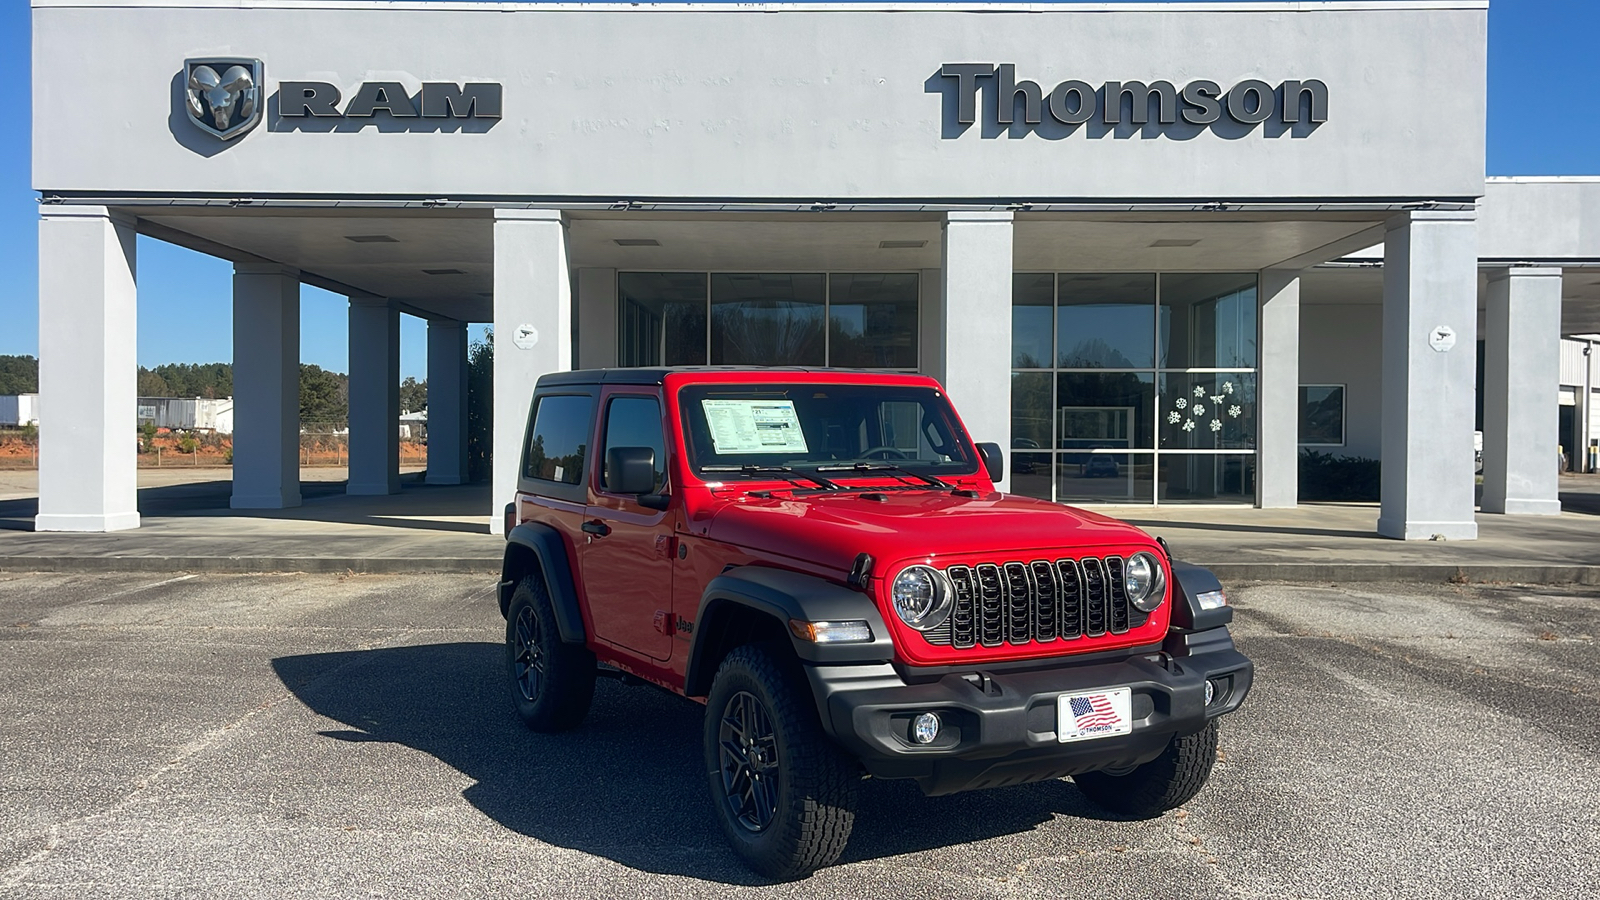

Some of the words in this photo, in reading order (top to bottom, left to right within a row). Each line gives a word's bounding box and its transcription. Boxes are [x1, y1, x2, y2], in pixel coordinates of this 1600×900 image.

[278, 82, 503, 119] RAM
[941, 63, 1328, 125] Thomson
[1086, 725, 1112, 733] THOMSON
